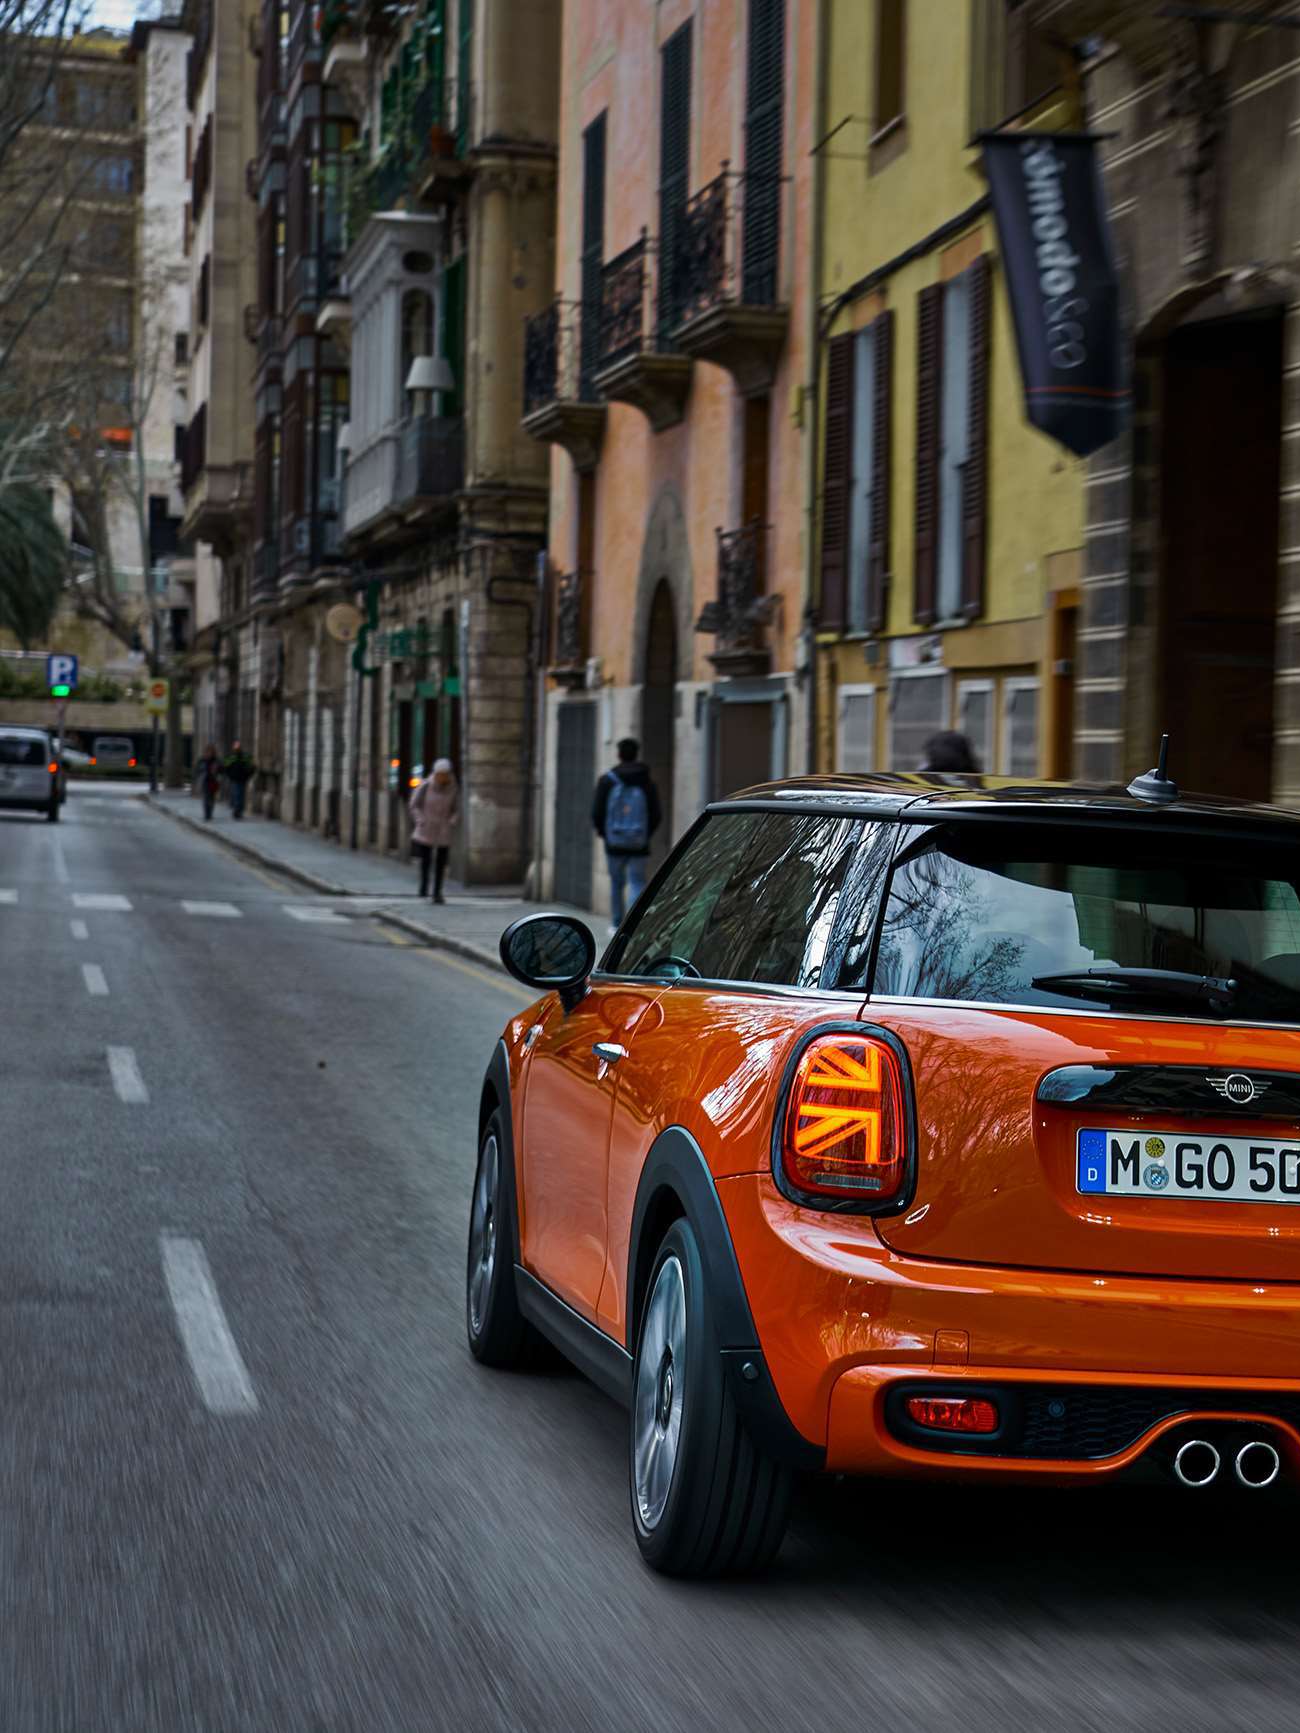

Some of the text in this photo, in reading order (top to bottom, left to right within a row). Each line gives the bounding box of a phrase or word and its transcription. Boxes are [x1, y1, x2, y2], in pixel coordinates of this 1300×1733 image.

[50, 656, 75, 685] P
[1229, 1083, 1251, 1093] MINI
[1087, 1167, 1098, 1182] D
[1110, 1138, 1140, 1186] M
[1175, 1142, 1236, 1190] GO
